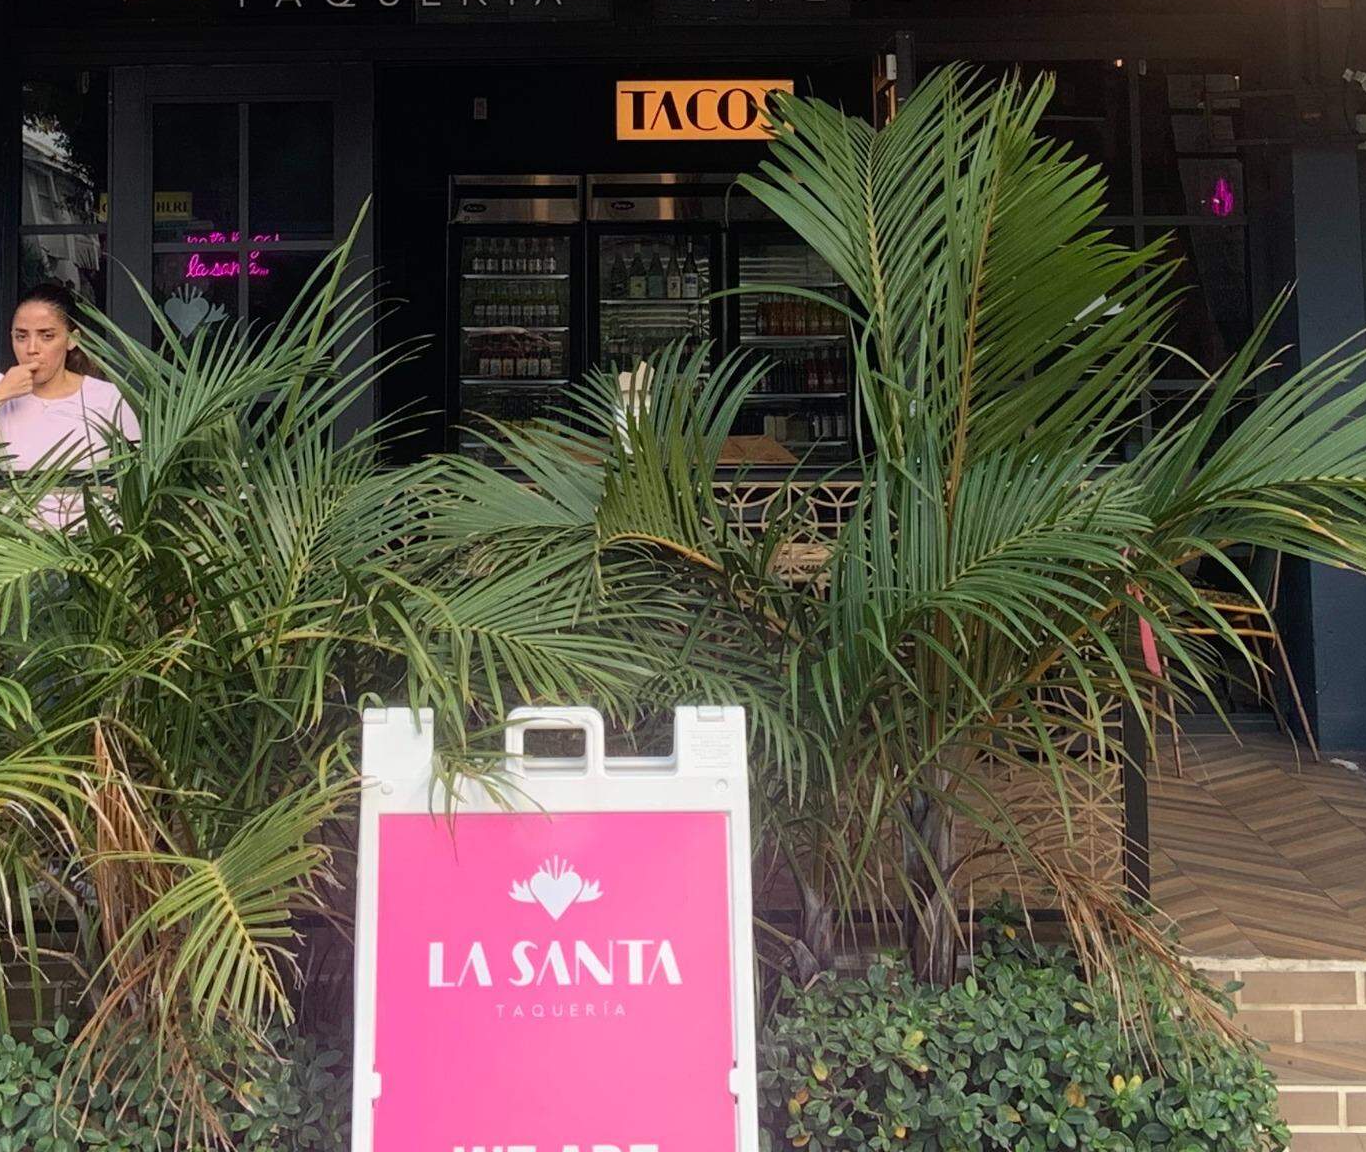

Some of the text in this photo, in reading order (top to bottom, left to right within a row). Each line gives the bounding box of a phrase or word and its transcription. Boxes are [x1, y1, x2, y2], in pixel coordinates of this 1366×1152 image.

[428, 939, 683, 988] LA SANTA
[496, 1000, 627, 1018] TAQUERÍA
